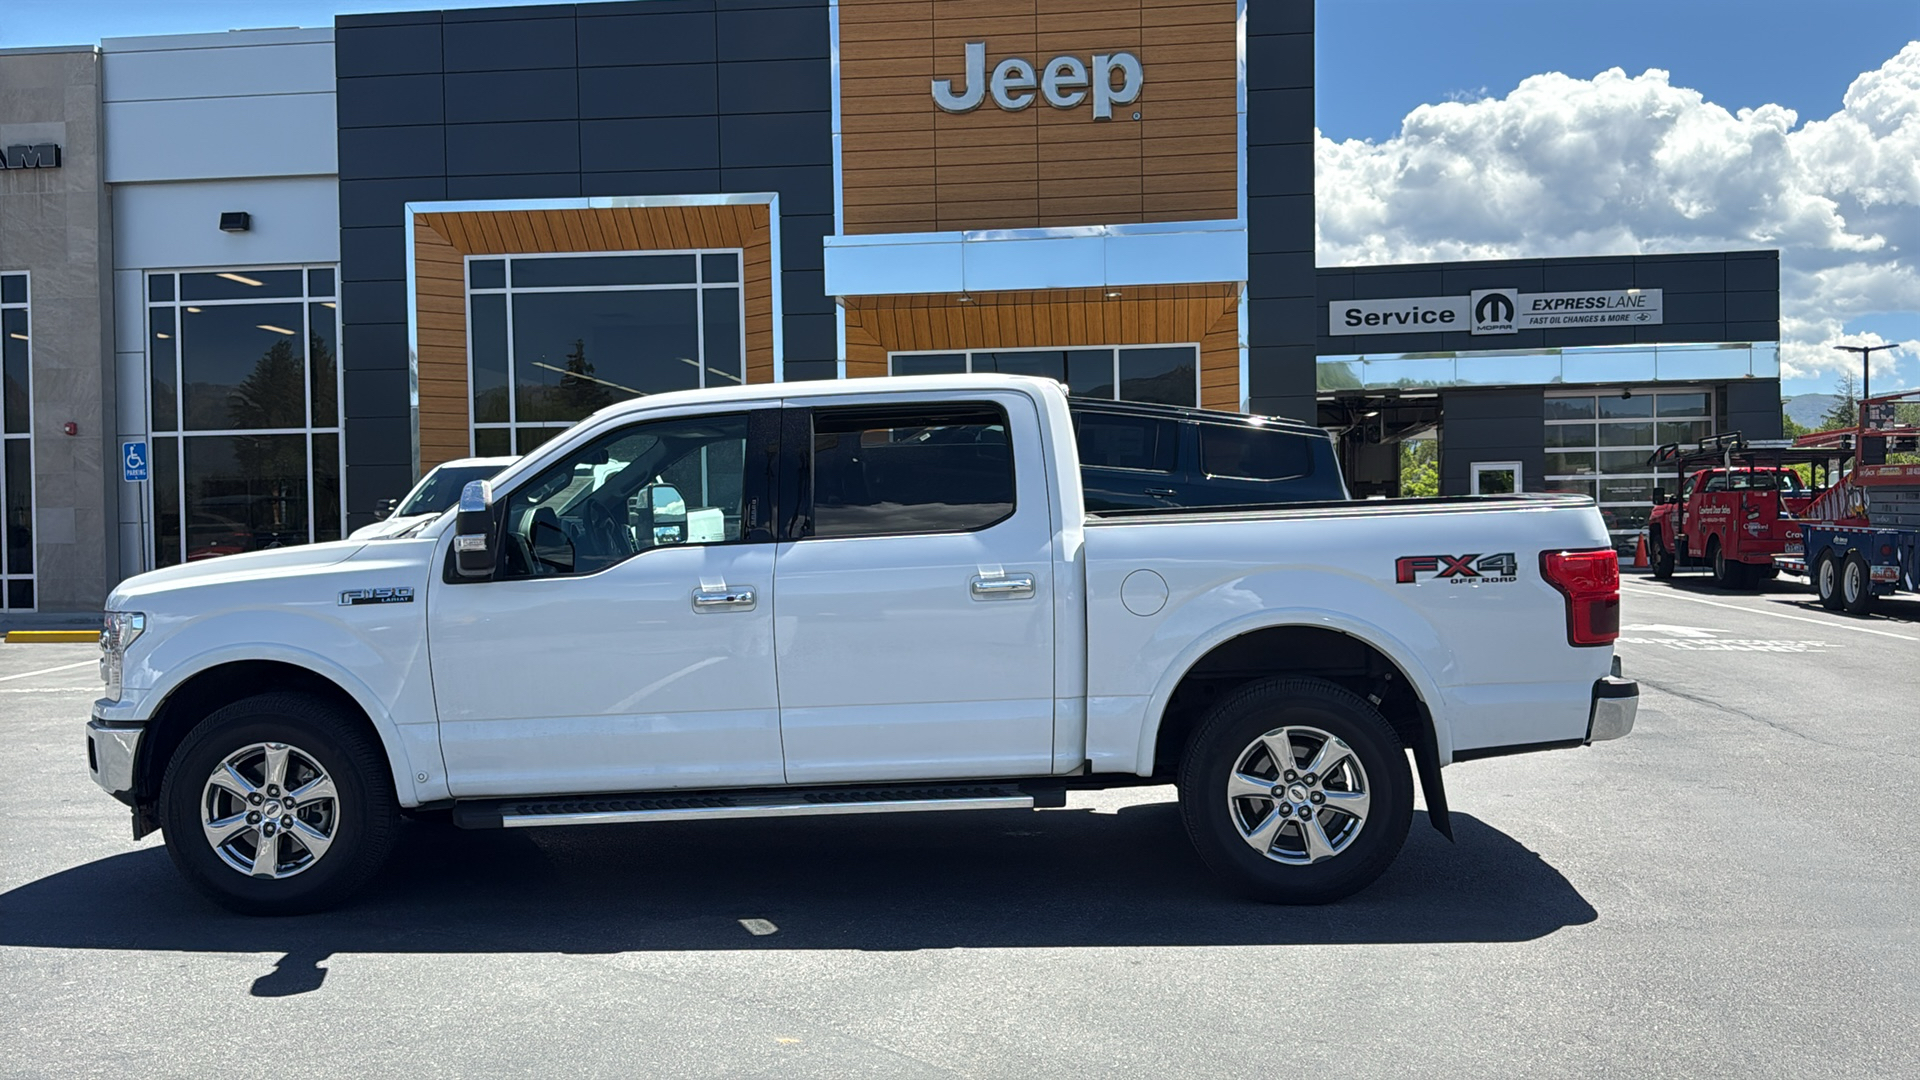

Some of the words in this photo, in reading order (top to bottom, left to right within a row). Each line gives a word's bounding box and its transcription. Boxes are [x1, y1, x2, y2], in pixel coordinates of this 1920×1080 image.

[931, 41, 1143, 121] Jeep
[1345, 306, 1455, 327] Service
[1529, 317, 1548, 325] FAST
[1549, 316, 1562, 324] OIL
[1563, 315, 1599, 324] CHANGES
[1599, 314, 1606, 323] &
[1607, 314, 1631, 322] MORE
[1395, 552, 1518, 584] FX4
